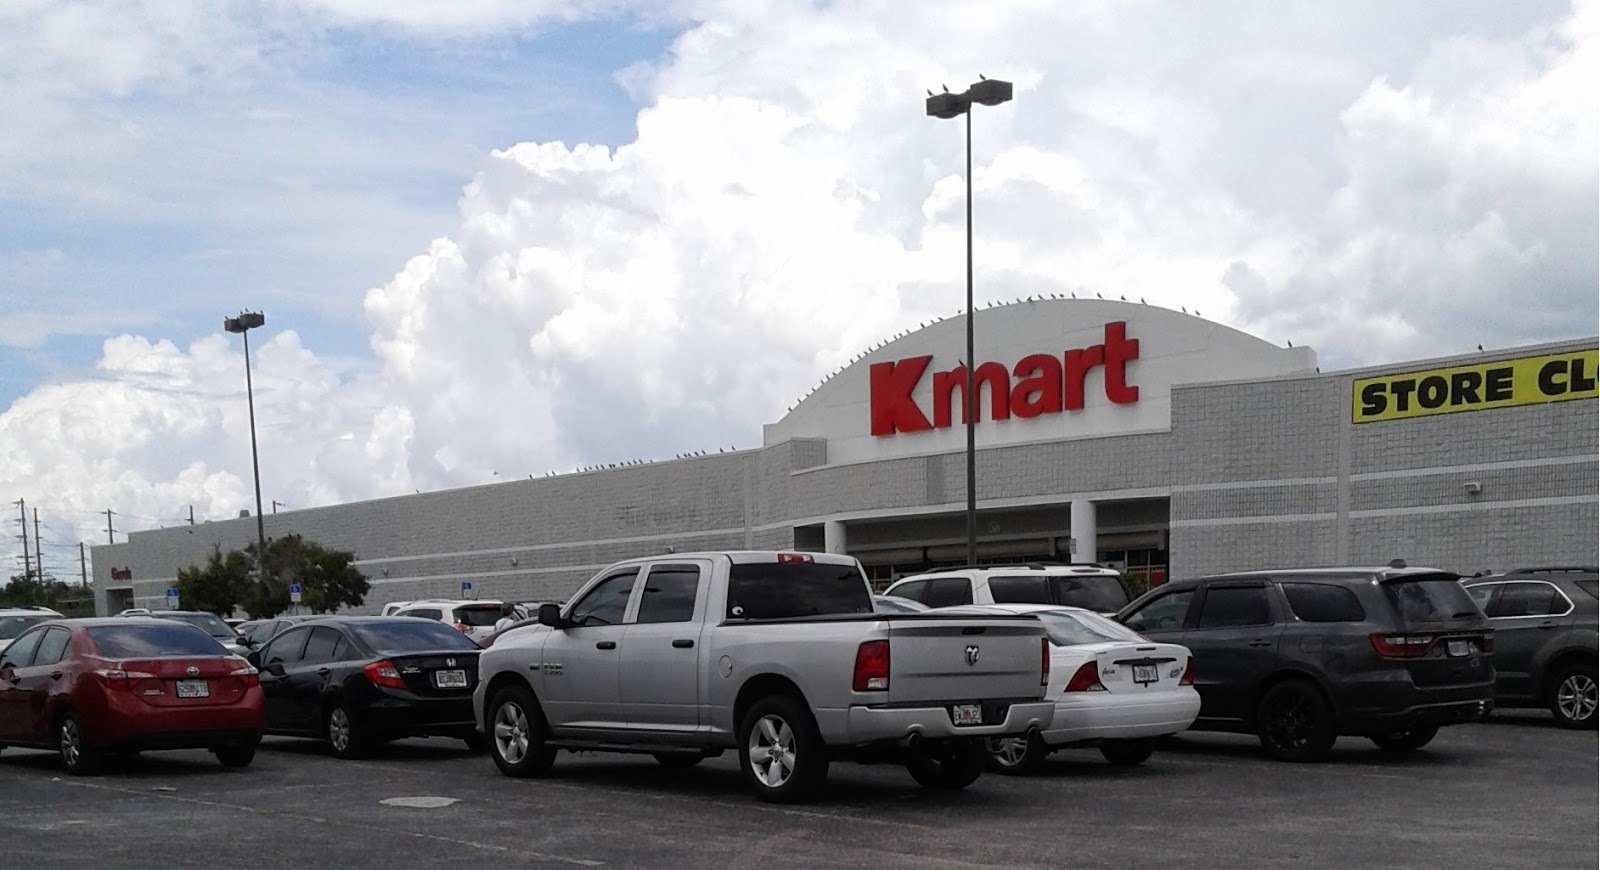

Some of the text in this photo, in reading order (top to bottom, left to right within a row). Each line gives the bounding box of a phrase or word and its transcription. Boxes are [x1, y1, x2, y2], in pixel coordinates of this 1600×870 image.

[870, 321, 1139, 436] Kmart
[1361, 358, 1600, 416] STORE CL
